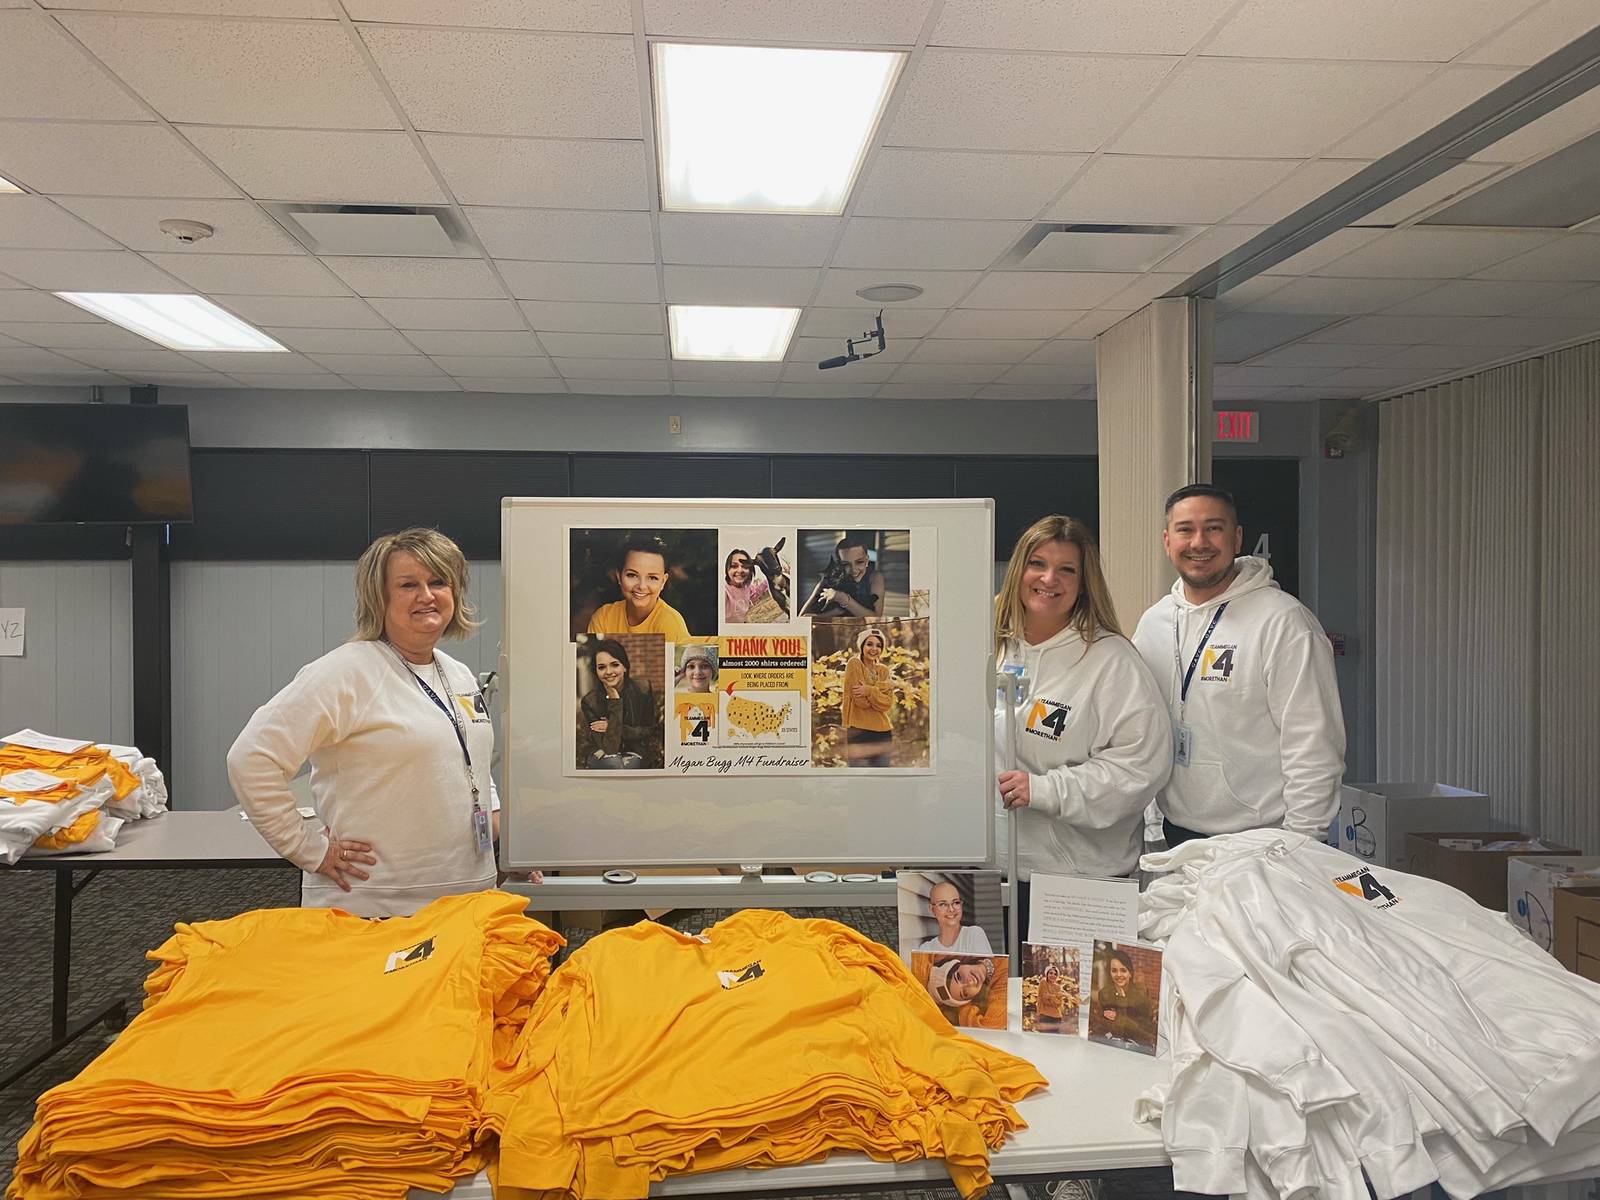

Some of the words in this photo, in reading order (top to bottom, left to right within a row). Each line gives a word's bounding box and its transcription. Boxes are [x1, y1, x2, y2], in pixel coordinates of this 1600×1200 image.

[1217, 411, 1253, 440] EXIT
[1252, 533, 1272, 559] 4
[726, 638, 768, 656] THANK
[772, 638, 801, 656] YOU!
[422, 684, 440, 703] GAVC
[1041, 698, 1072, 711] TEAMMEGAN
[668, 755, 705, 774] Megan
[706, 755, 732, 774] Bugg
[733, 754, 755, 767] M4
[755, 755, 810, 767] Fundraiser
[1351, 806, 1376, 858] B
